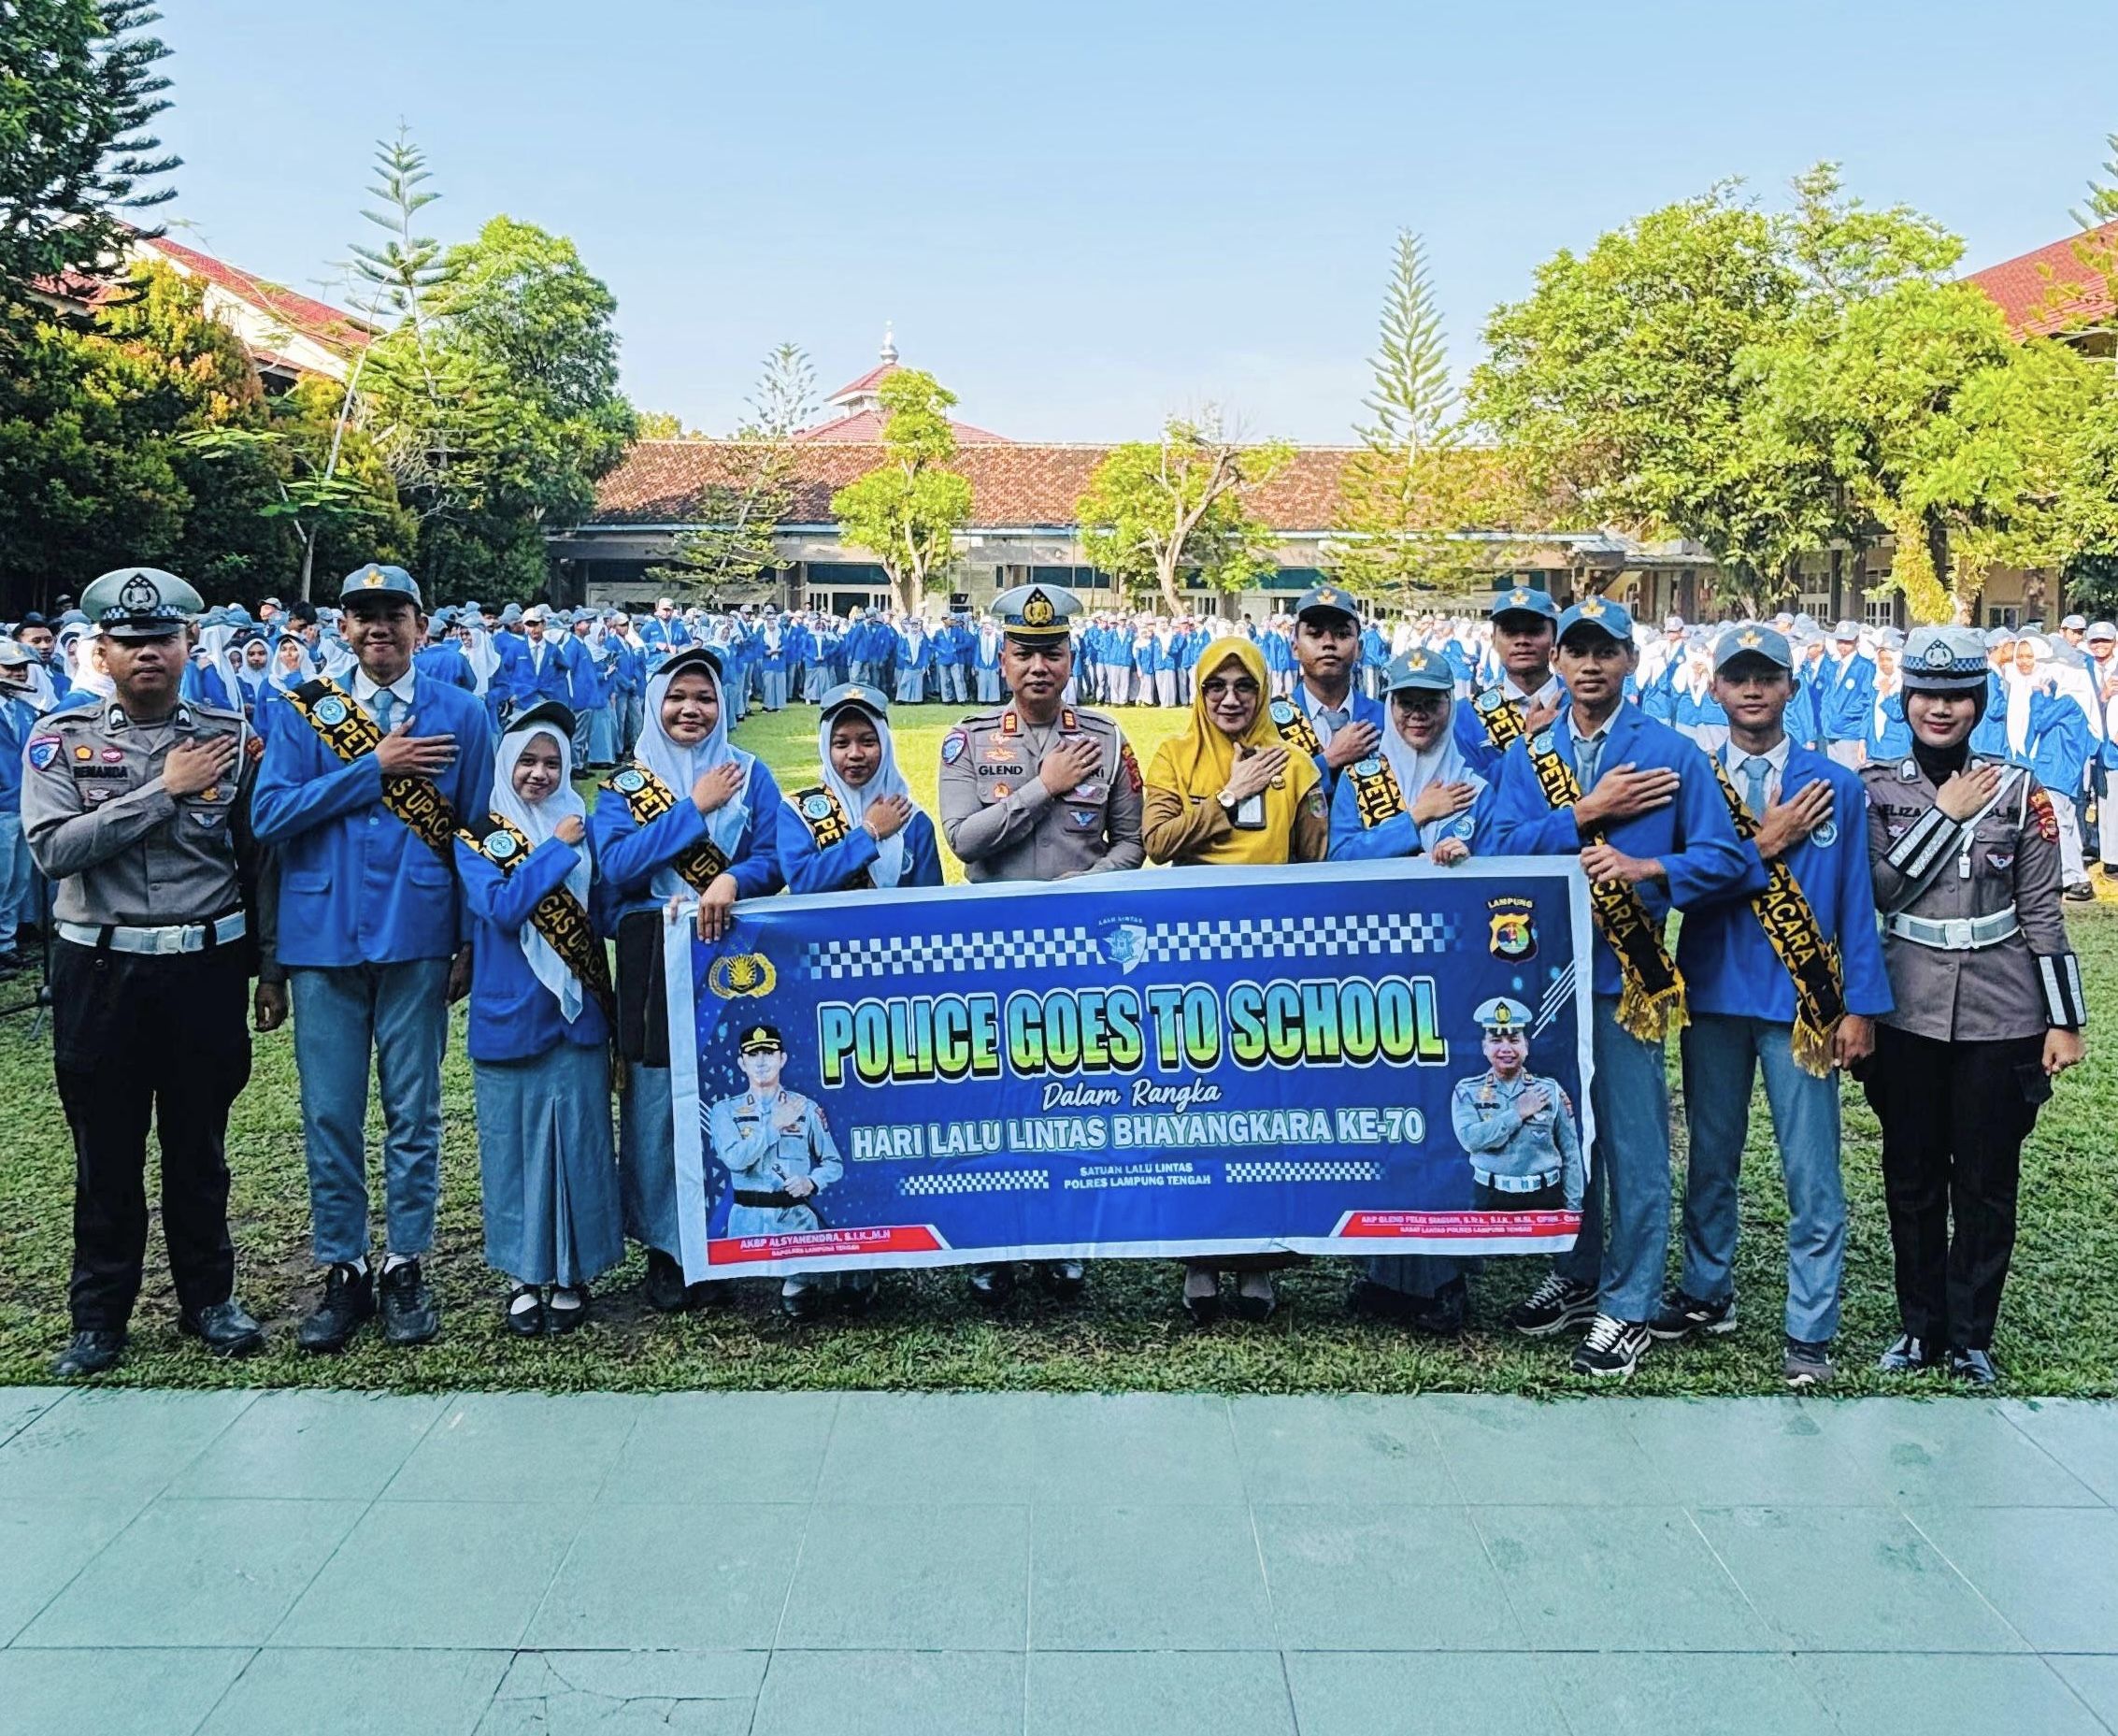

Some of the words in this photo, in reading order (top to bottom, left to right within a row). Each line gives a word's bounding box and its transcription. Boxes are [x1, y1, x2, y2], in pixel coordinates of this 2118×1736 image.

[979, 765, 1023, 776] GLEND
[631, 786, 668, 819] PET
[1487, 897, 1533, 909] LAMPUNG
[818, 993, 1000, 1088] POLICE
[1009, 985, 1145, 1078] GOES
[1148, 983, 1221, 1074] TO
[1228, 975, 1450, 1073] SCHOOL
[1042, 1080, 1121, 1112] Dalam
[1132, 1077, 1222, 1114] Rangka
[851, 1125, 923, 1161] HARI
[930, 1121, 1001, 1156] LALU
[1010, 1117, 1106, 1153] LINTAS
[1114, 1110, 1332, 1149] BHAYANGKARA
[1337, 1107, 1425, 1144] KE-70
[1080, 1166, 1123, 1176] SATUAN
[1125, 1164, 1152, 1174] LALU
[1155, 1162, 1194, 1173] LINTAS
[1064, 1178, 1108, 1189] POLRES
[1110, 1175, 1165, 1187] LAMPUNG
[1166, 1174, 1211, 1185] TENGAH
[740, 1238, 766, 1249] AKBP
